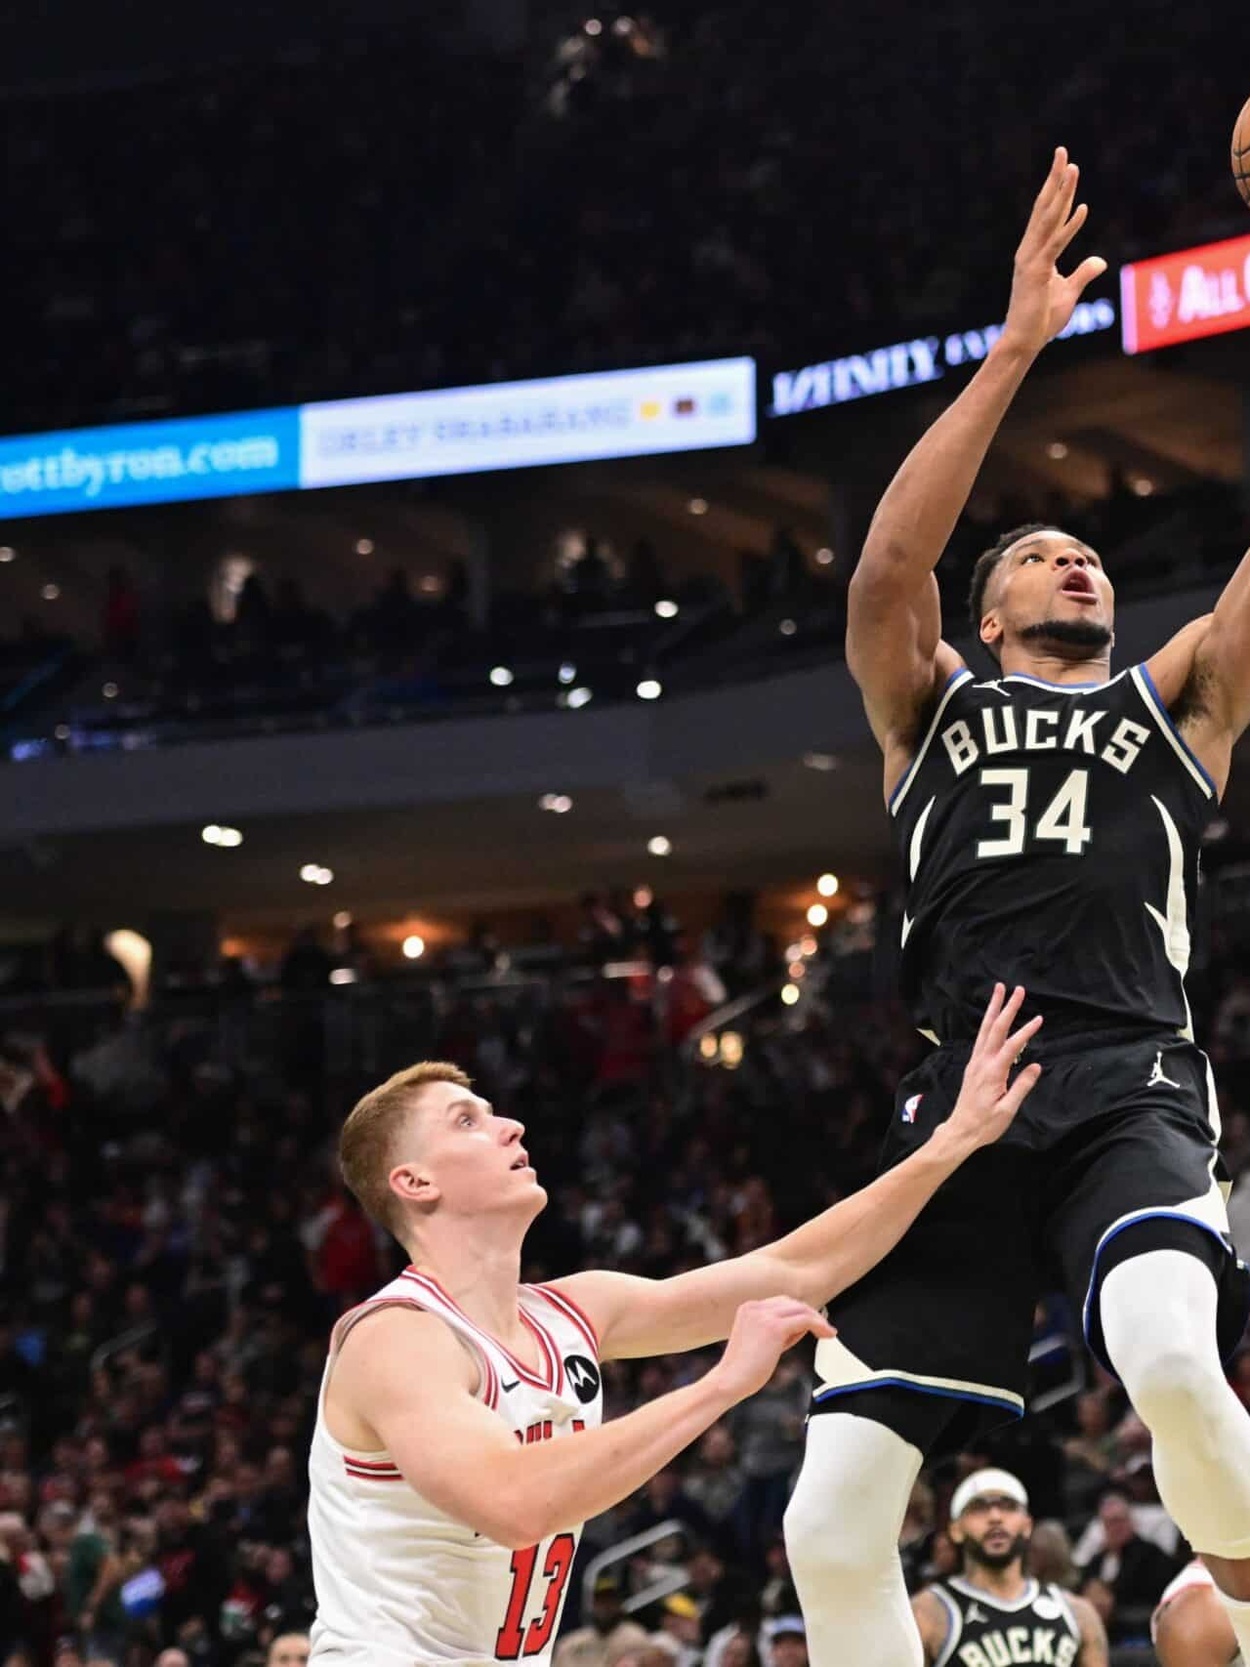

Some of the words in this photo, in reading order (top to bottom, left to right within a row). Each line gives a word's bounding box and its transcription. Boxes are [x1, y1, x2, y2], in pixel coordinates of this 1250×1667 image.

[941, 705, 1151, 776] BUCKS
[976, 767, 1093, 858] 34
[494, 1532, 576, 1661] 13
[957, 1625, 1078, 1667] BUCKS
